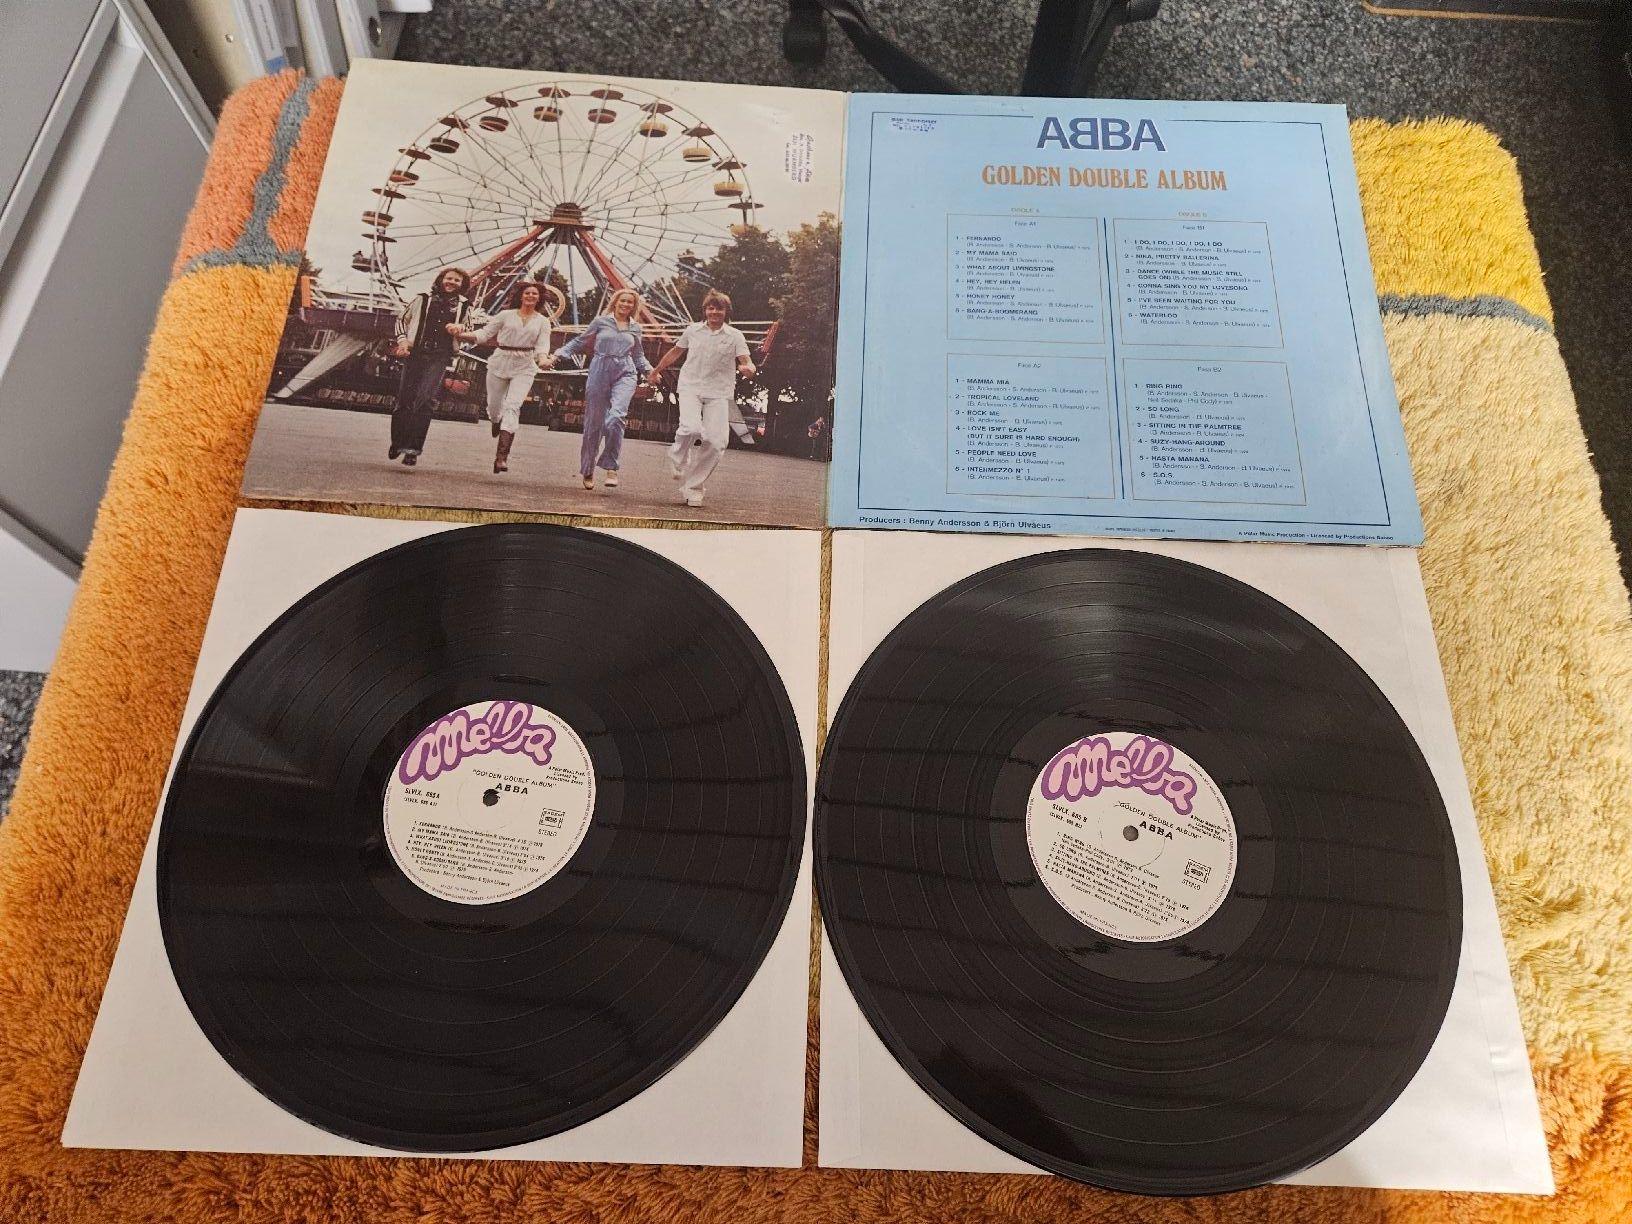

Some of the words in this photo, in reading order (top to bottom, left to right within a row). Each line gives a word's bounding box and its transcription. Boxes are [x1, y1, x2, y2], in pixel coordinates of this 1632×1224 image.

[1037, 117, 1166, 151] ABBA
[982, 165, 1061, 187] GOLDEN
[1069, 167, 1148, 189] DOUBLE
[1157, 169, 1227, 191] ALBUM
[1150, 439, 1226, 447] SUZY-HANG-AROUND
[968, 466, 1013, 474] INTERMEZZO
[859, 516, 901, 525] Producers
[909, 518, 934, 527] Benny
[938, 518, 981, 527] Andersson
[993, 520, 1015, 530] Björn
[1018, 521, 1052, 529] Ulvaeus
[503, 774, 530, 785] DOUBLE
[496, 782, 529, 795] ABBA
[1147, 814, 1175, 829] DOUBLE
[1138, 820, 1175, 840] ABBA
